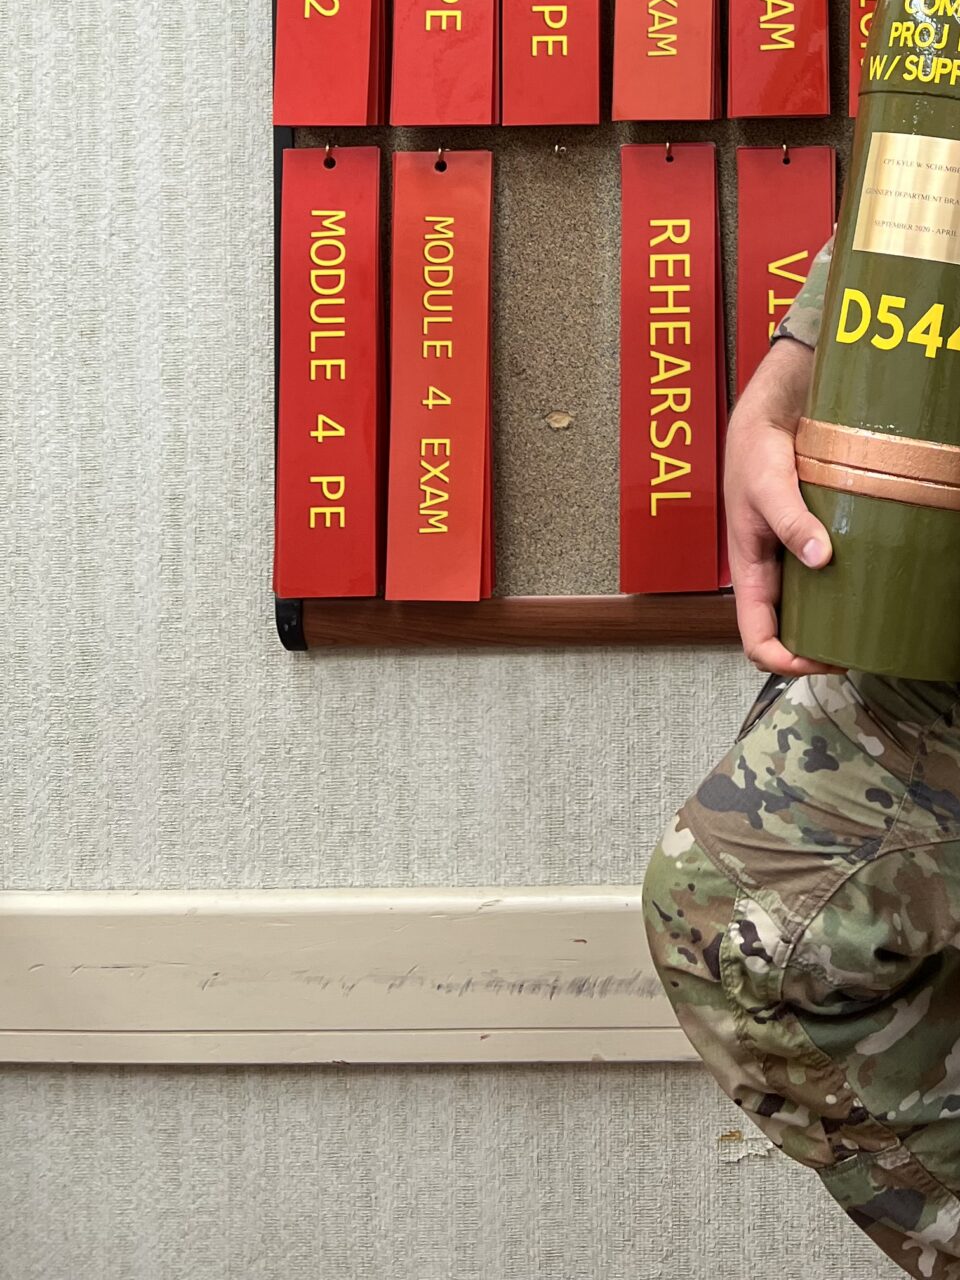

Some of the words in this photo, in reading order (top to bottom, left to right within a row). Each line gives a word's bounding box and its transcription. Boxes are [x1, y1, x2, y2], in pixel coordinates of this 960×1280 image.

[531, 4, 568, 57] PE
[889, 22, 948, 50] PROJ
[869, 53, 903, 81] W/
[309, 209, 347, 381] MODULE
[422, 215, 455, 359] MODULE
[649, 218, 692, 517] REHEARSAL
[422, 385, 452, 410] 4
[310, 414, 346, 443] 4
[309, 475, 346, 529] PE
[418, 438, 451, 534] EXAM
